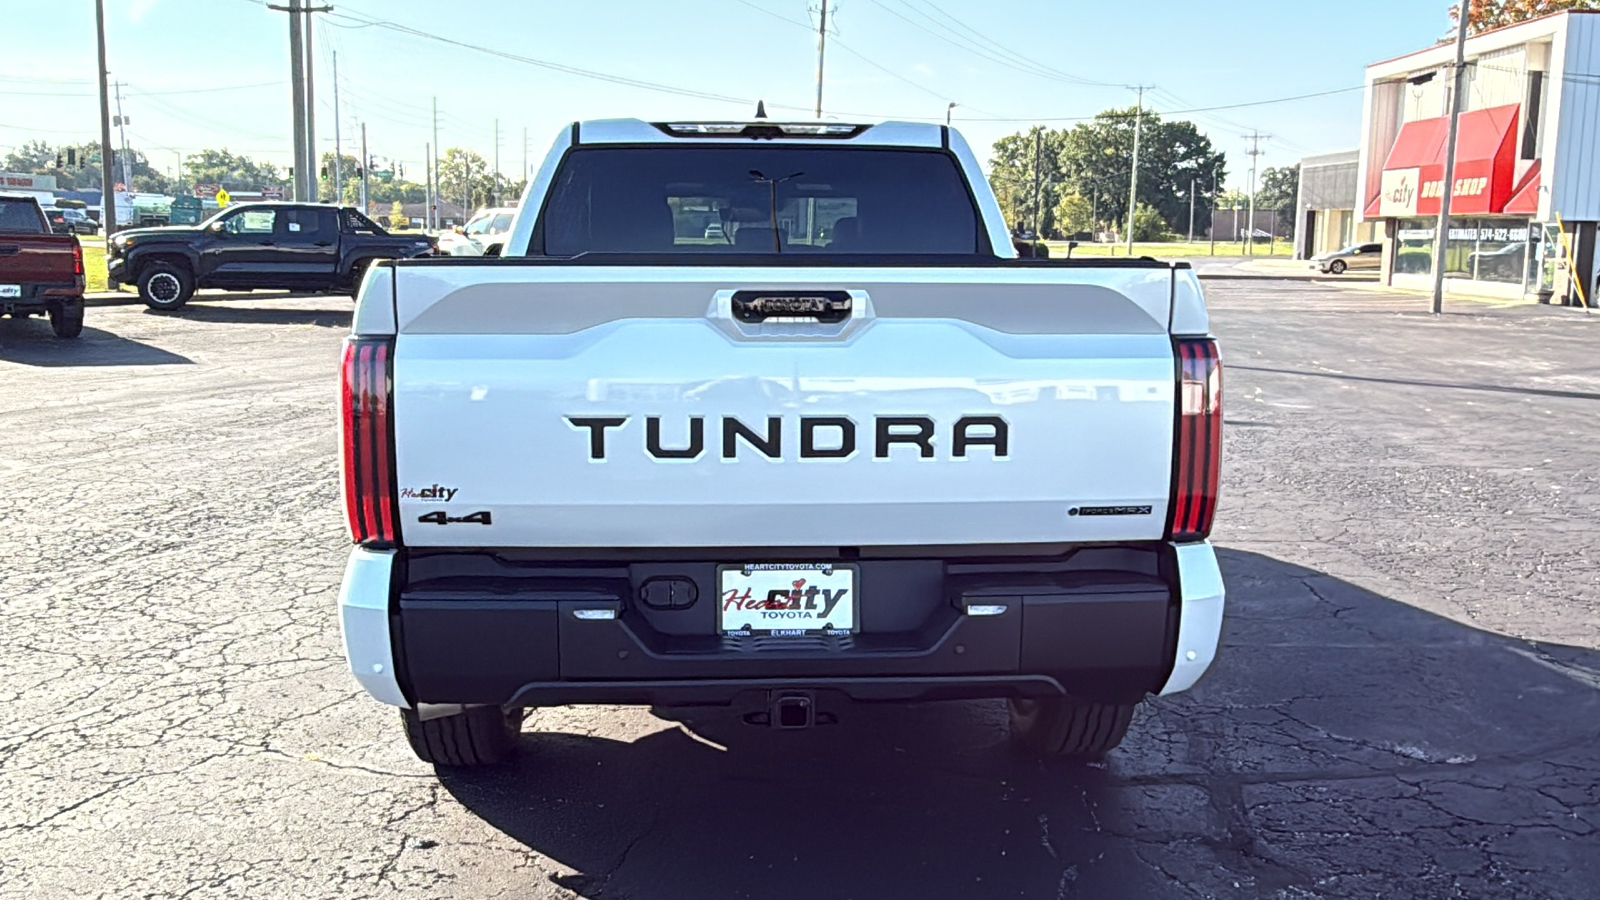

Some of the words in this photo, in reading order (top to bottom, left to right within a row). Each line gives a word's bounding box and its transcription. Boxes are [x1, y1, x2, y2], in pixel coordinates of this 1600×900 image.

[1393, 183, 1414, 208] city
[1421, 180, 1446, 198] BOD
[1453, 177, 1487, 196] SHOP
[562, 415, 1012, 464] TUNDRA
[421, 484, 458, 502] city
[418, 511, 492, 525] 4x4
[744, 563, 833, 571] HEARTCITYTOYOTA.COM
[760, 611, 812, 619] TOYOTA
[770, 629, 806, 637] ELKHART
